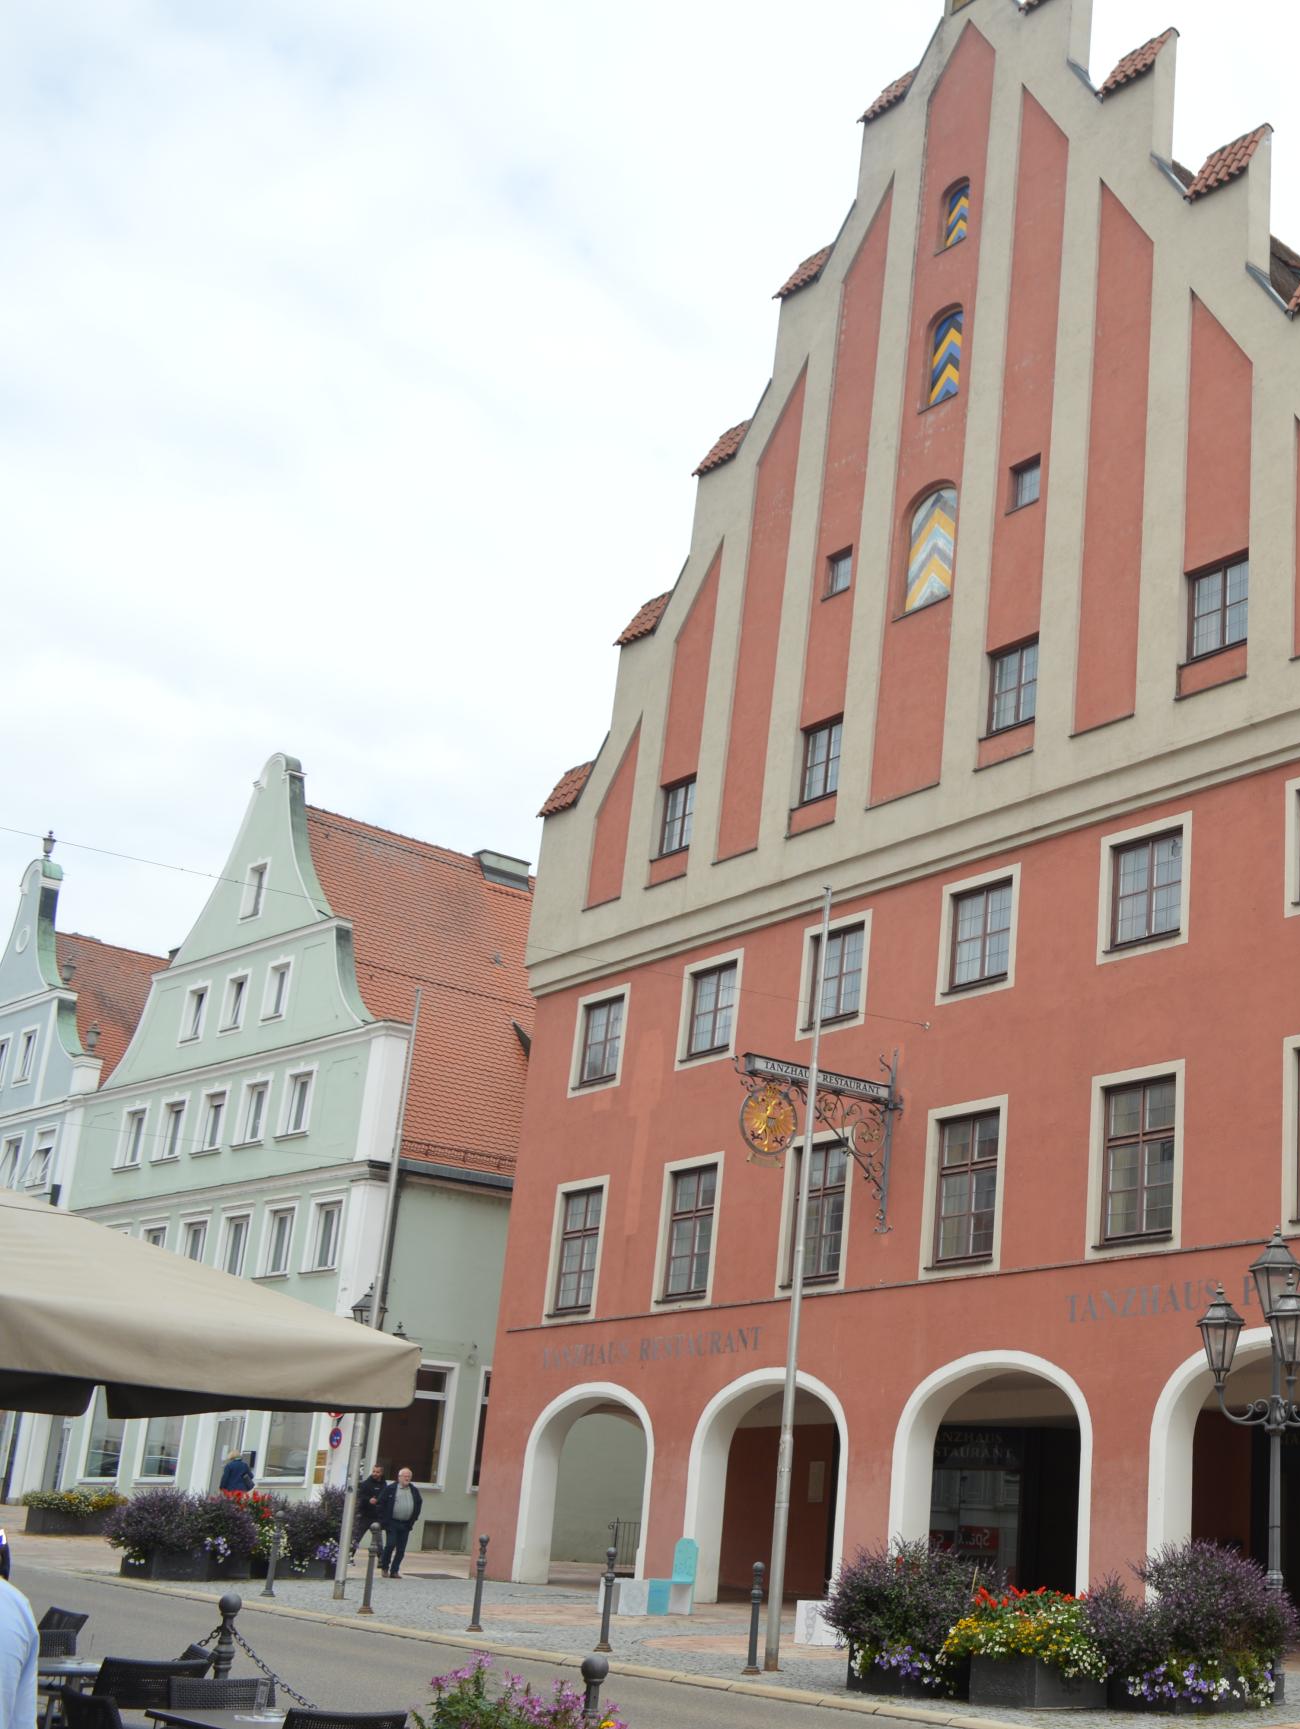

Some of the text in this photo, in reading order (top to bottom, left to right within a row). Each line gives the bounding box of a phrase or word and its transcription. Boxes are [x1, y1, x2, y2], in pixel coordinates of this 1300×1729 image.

[765, 1061, 809, 1078] TANZHAU
[822, 1074, 881, 1095] RESTAURANT
[541, 1325, 764, 1370] TANZHAUS RESTAURANT
